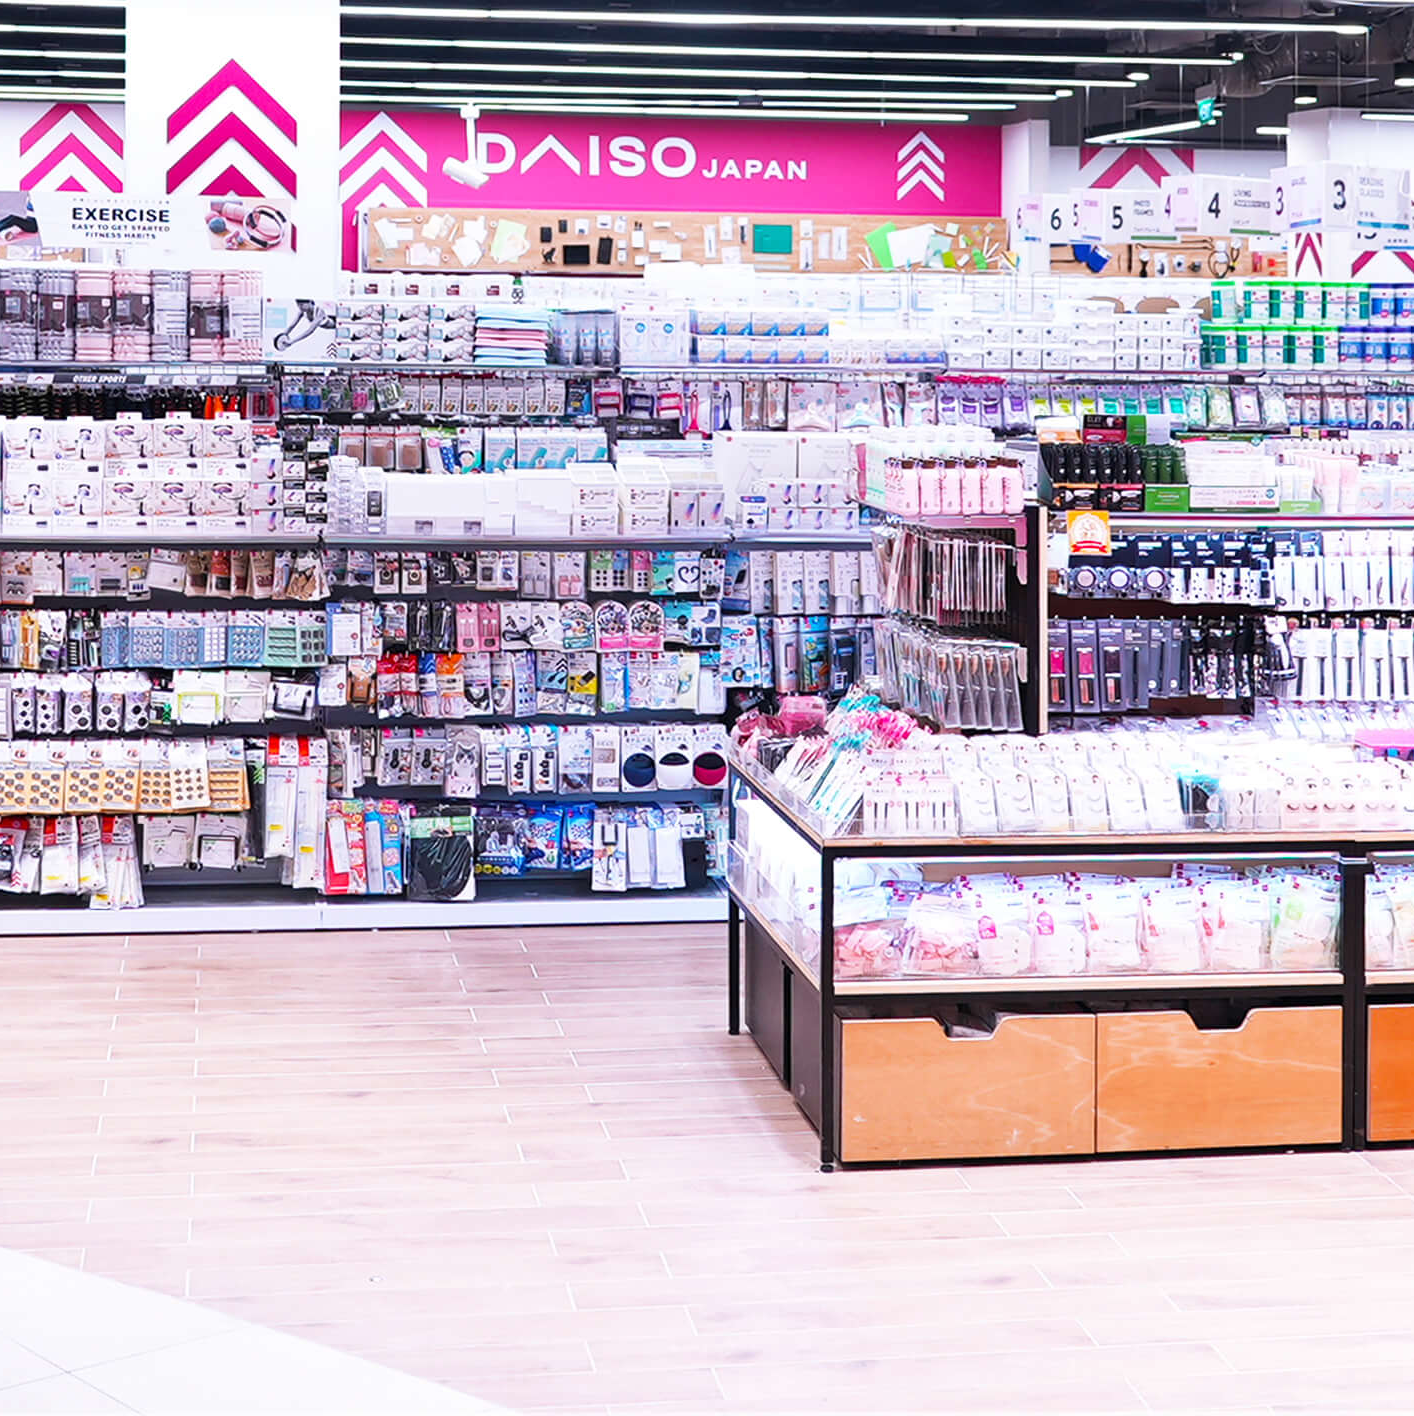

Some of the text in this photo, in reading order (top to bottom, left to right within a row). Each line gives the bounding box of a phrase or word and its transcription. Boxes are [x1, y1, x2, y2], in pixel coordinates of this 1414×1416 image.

[477, 132, 808, 181] DAISO JAPAN
[1164, 194, 1172, 219] 4
[1207, 192, 1221, 219] 4
[1275, 186, 1284, 216] 3
[1332, 179, 1347, 211] 3
[72, 207, 170, 223] EXERCISE
[1050, 208, 1063, 231] 6
[1073, 203, 1079, 227] 5
[1111, 205, 1124, 230] 5
[131, 225, 171, 233] STARTED
[73, 374, 127, 383] OTHER SPORTS
